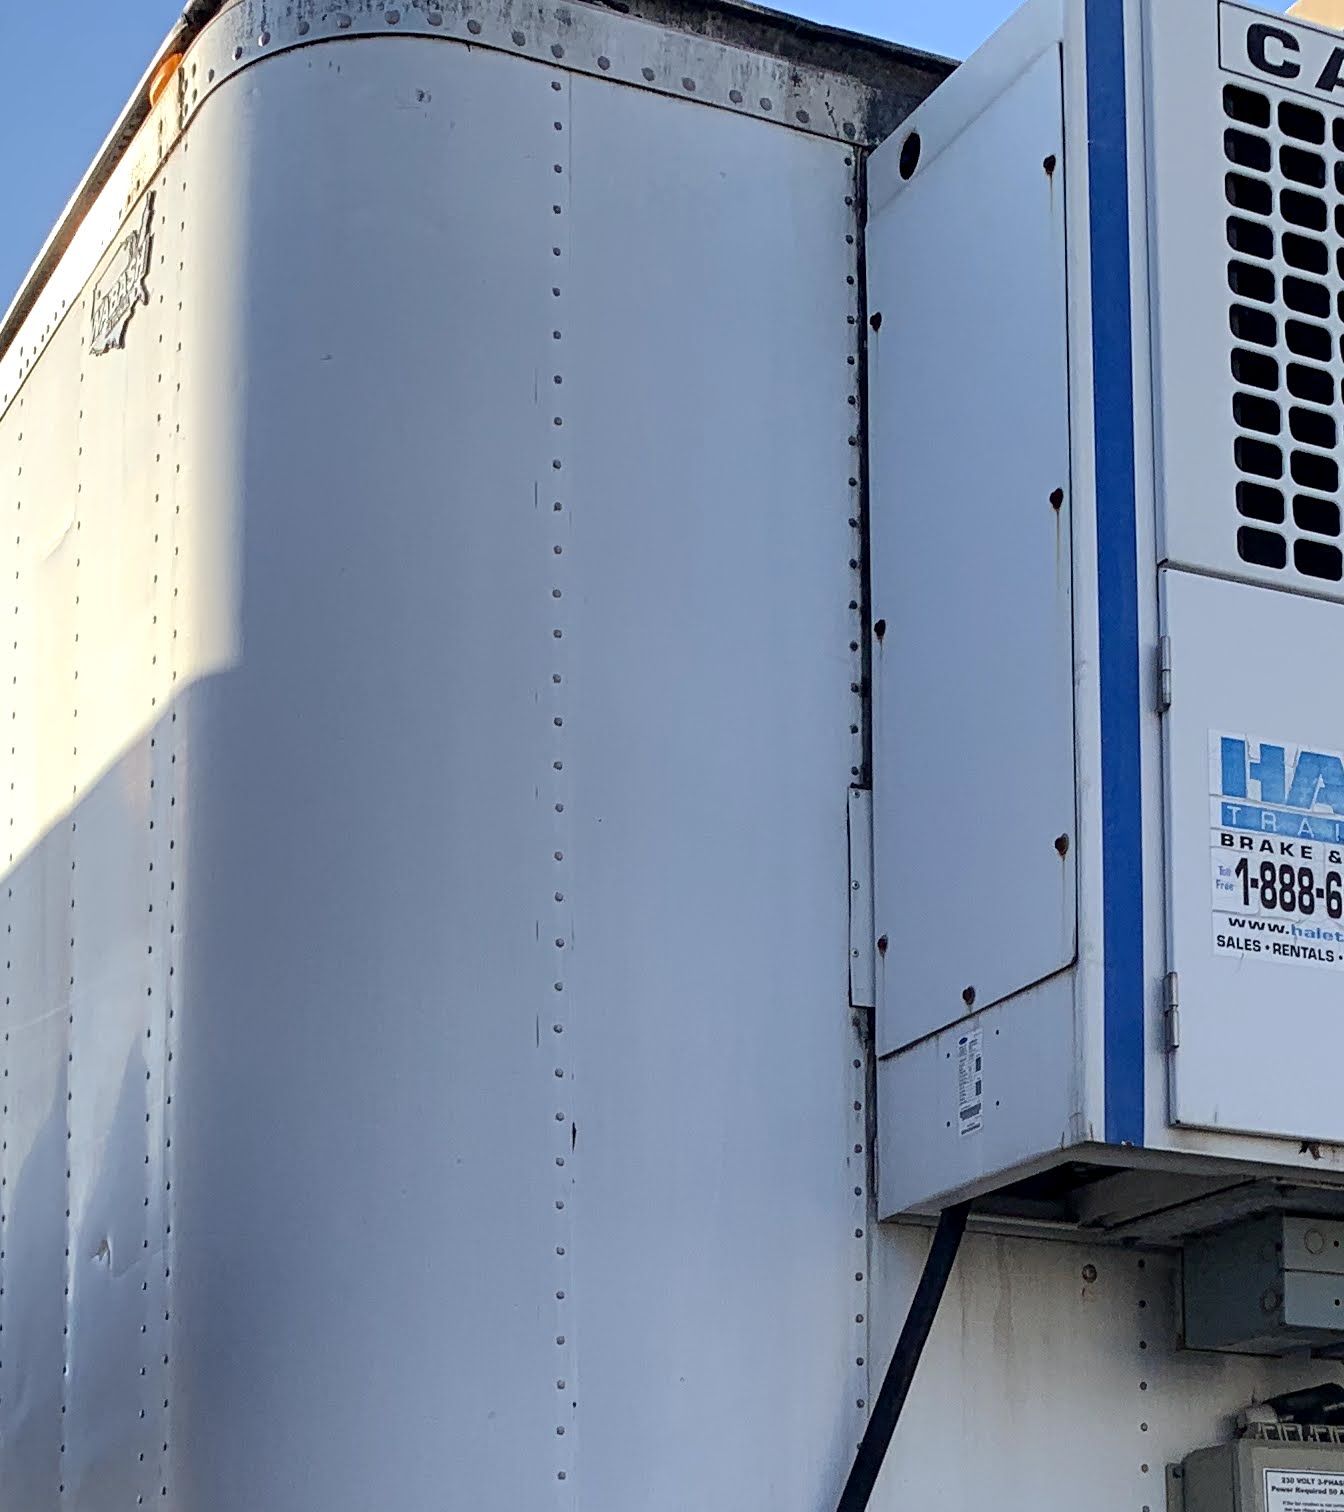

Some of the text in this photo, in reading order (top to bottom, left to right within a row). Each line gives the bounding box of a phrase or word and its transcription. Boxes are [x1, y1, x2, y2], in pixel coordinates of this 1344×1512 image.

[1221, 833, 1313, 860] BRAKE
[1328, 850, 1343, 865] &
[1216, 879, 1234, 891] Free
[1216, 934, 1261, 952] SALES
[1272, 942, 1335, 963] RENTALS
[1295, 1486, 1327, 1495] Required
